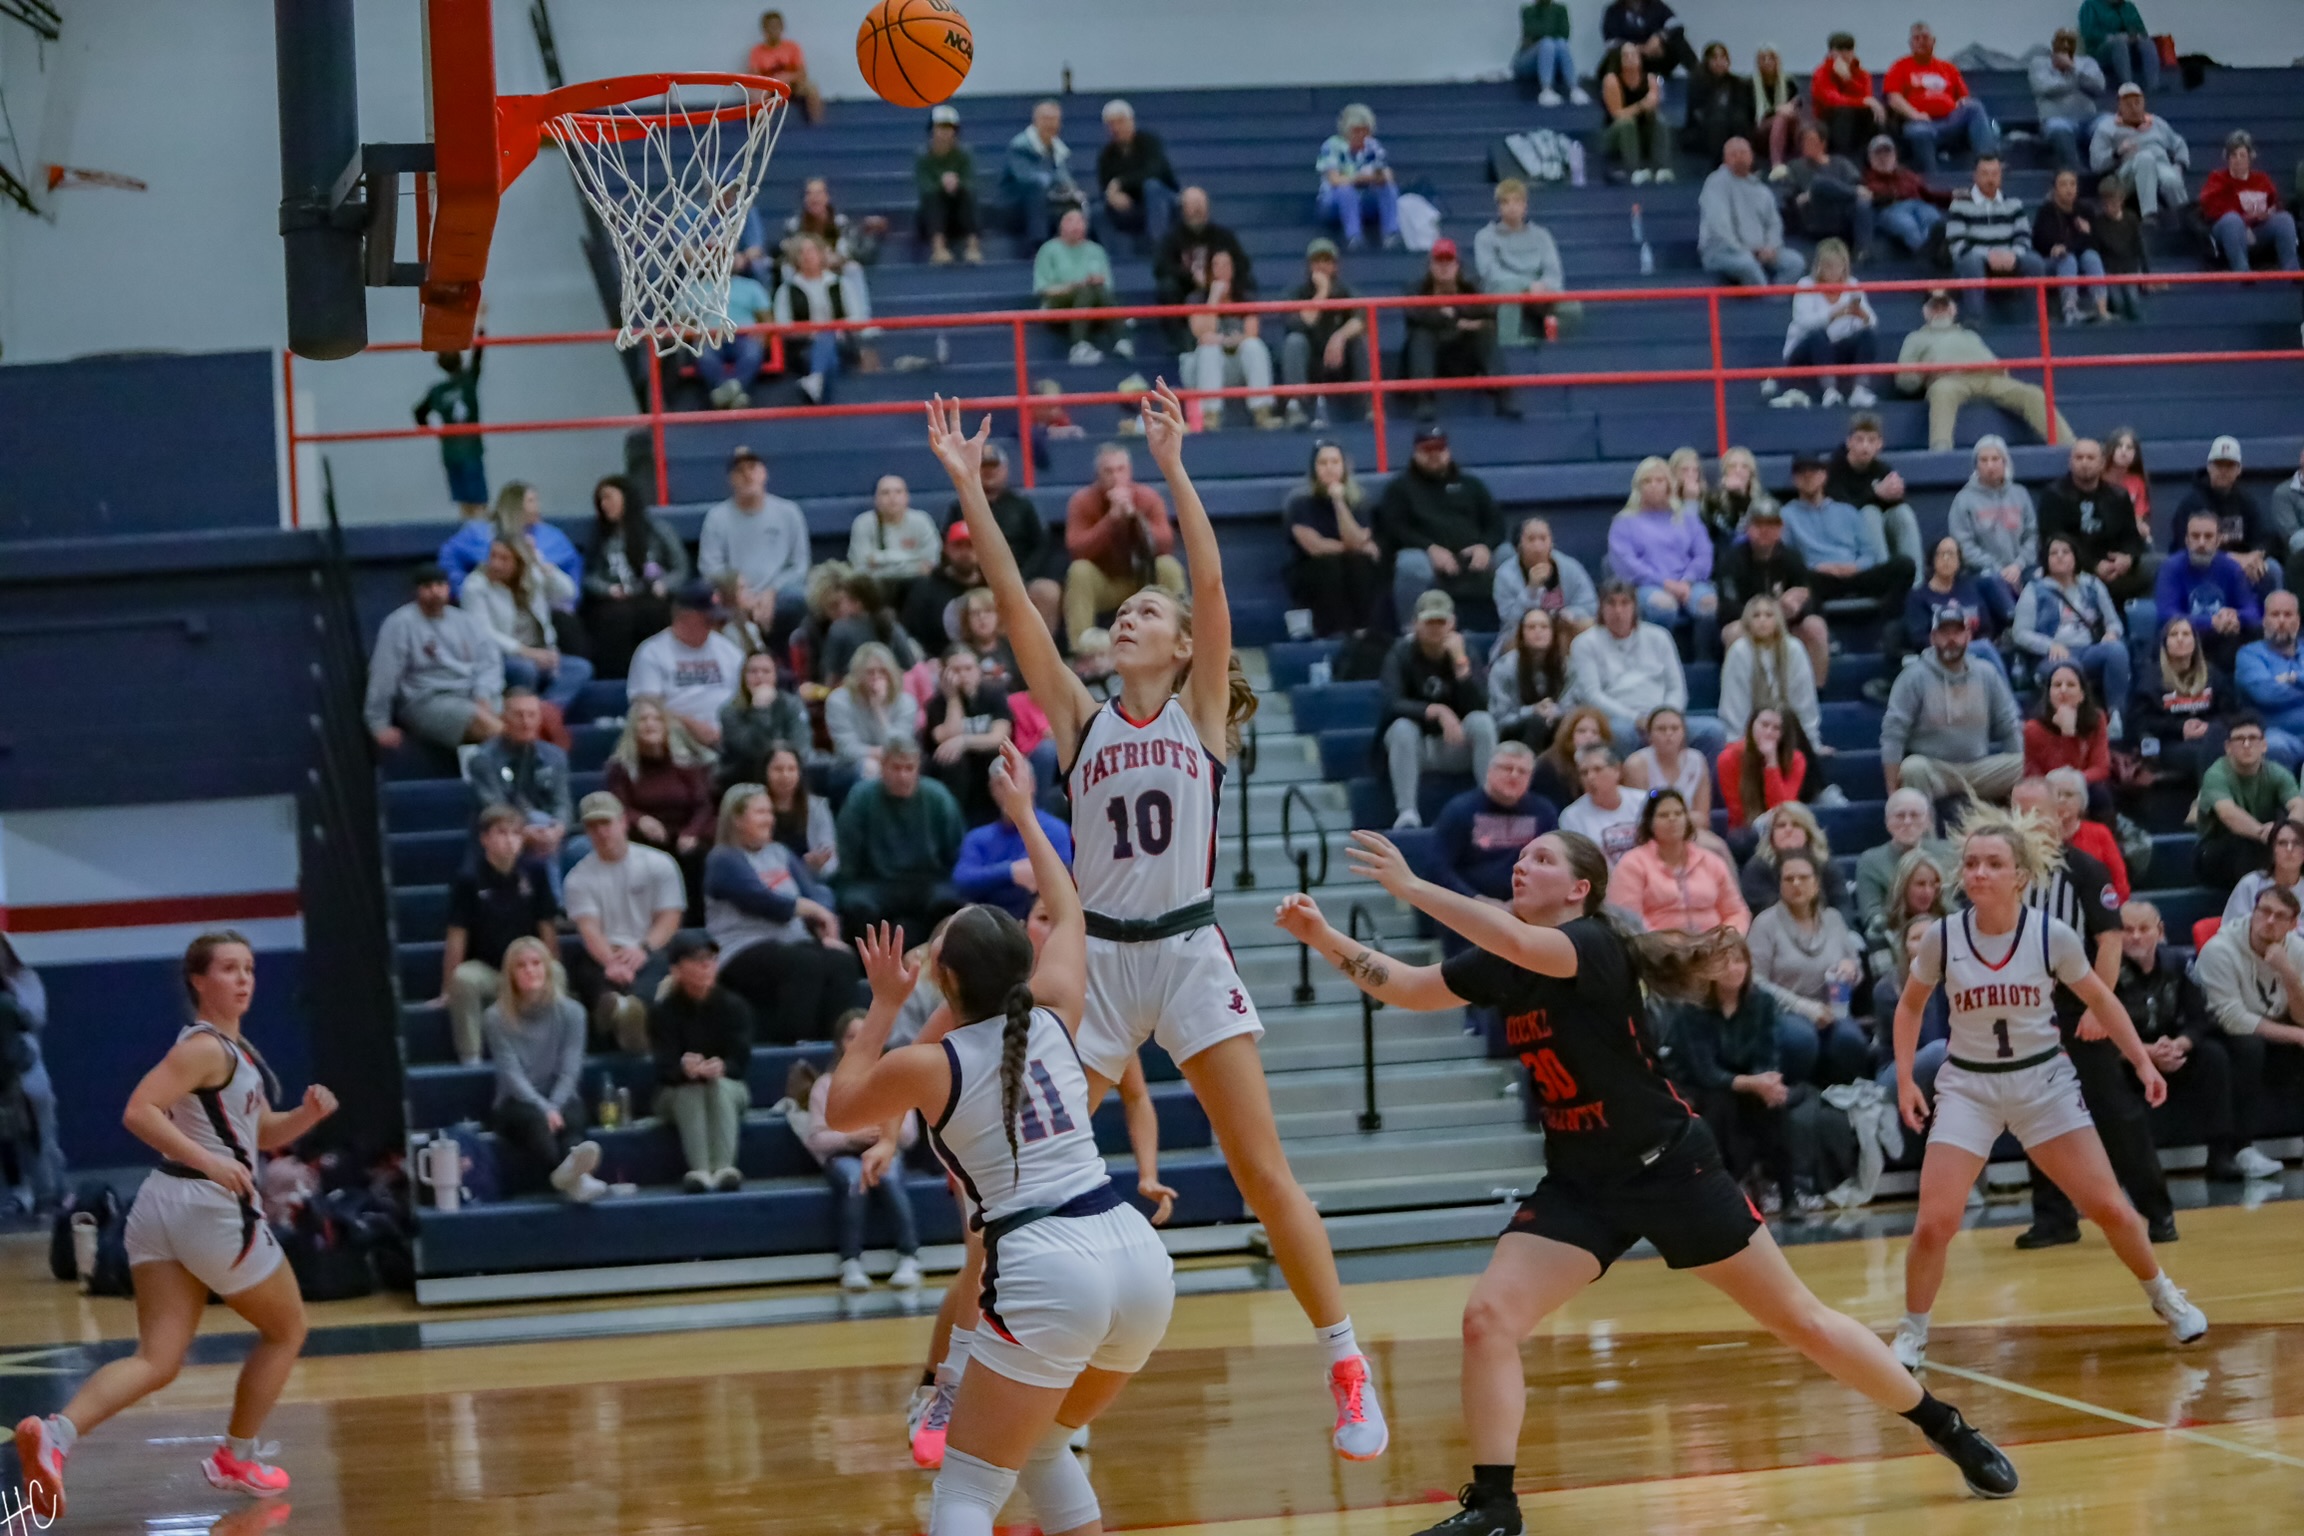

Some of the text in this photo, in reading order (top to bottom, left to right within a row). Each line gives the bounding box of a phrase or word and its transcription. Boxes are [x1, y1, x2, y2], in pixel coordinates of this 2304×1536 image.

[1083, 738, 1198, 796] PATRIOTS
[1106, 789, 1173, 860] 10
[1954, 984, 2041, 1012] PATRIOTS
[1992, 1018, 2014, 1058] 1
[1520, 1048, 1577, 1102] 30
